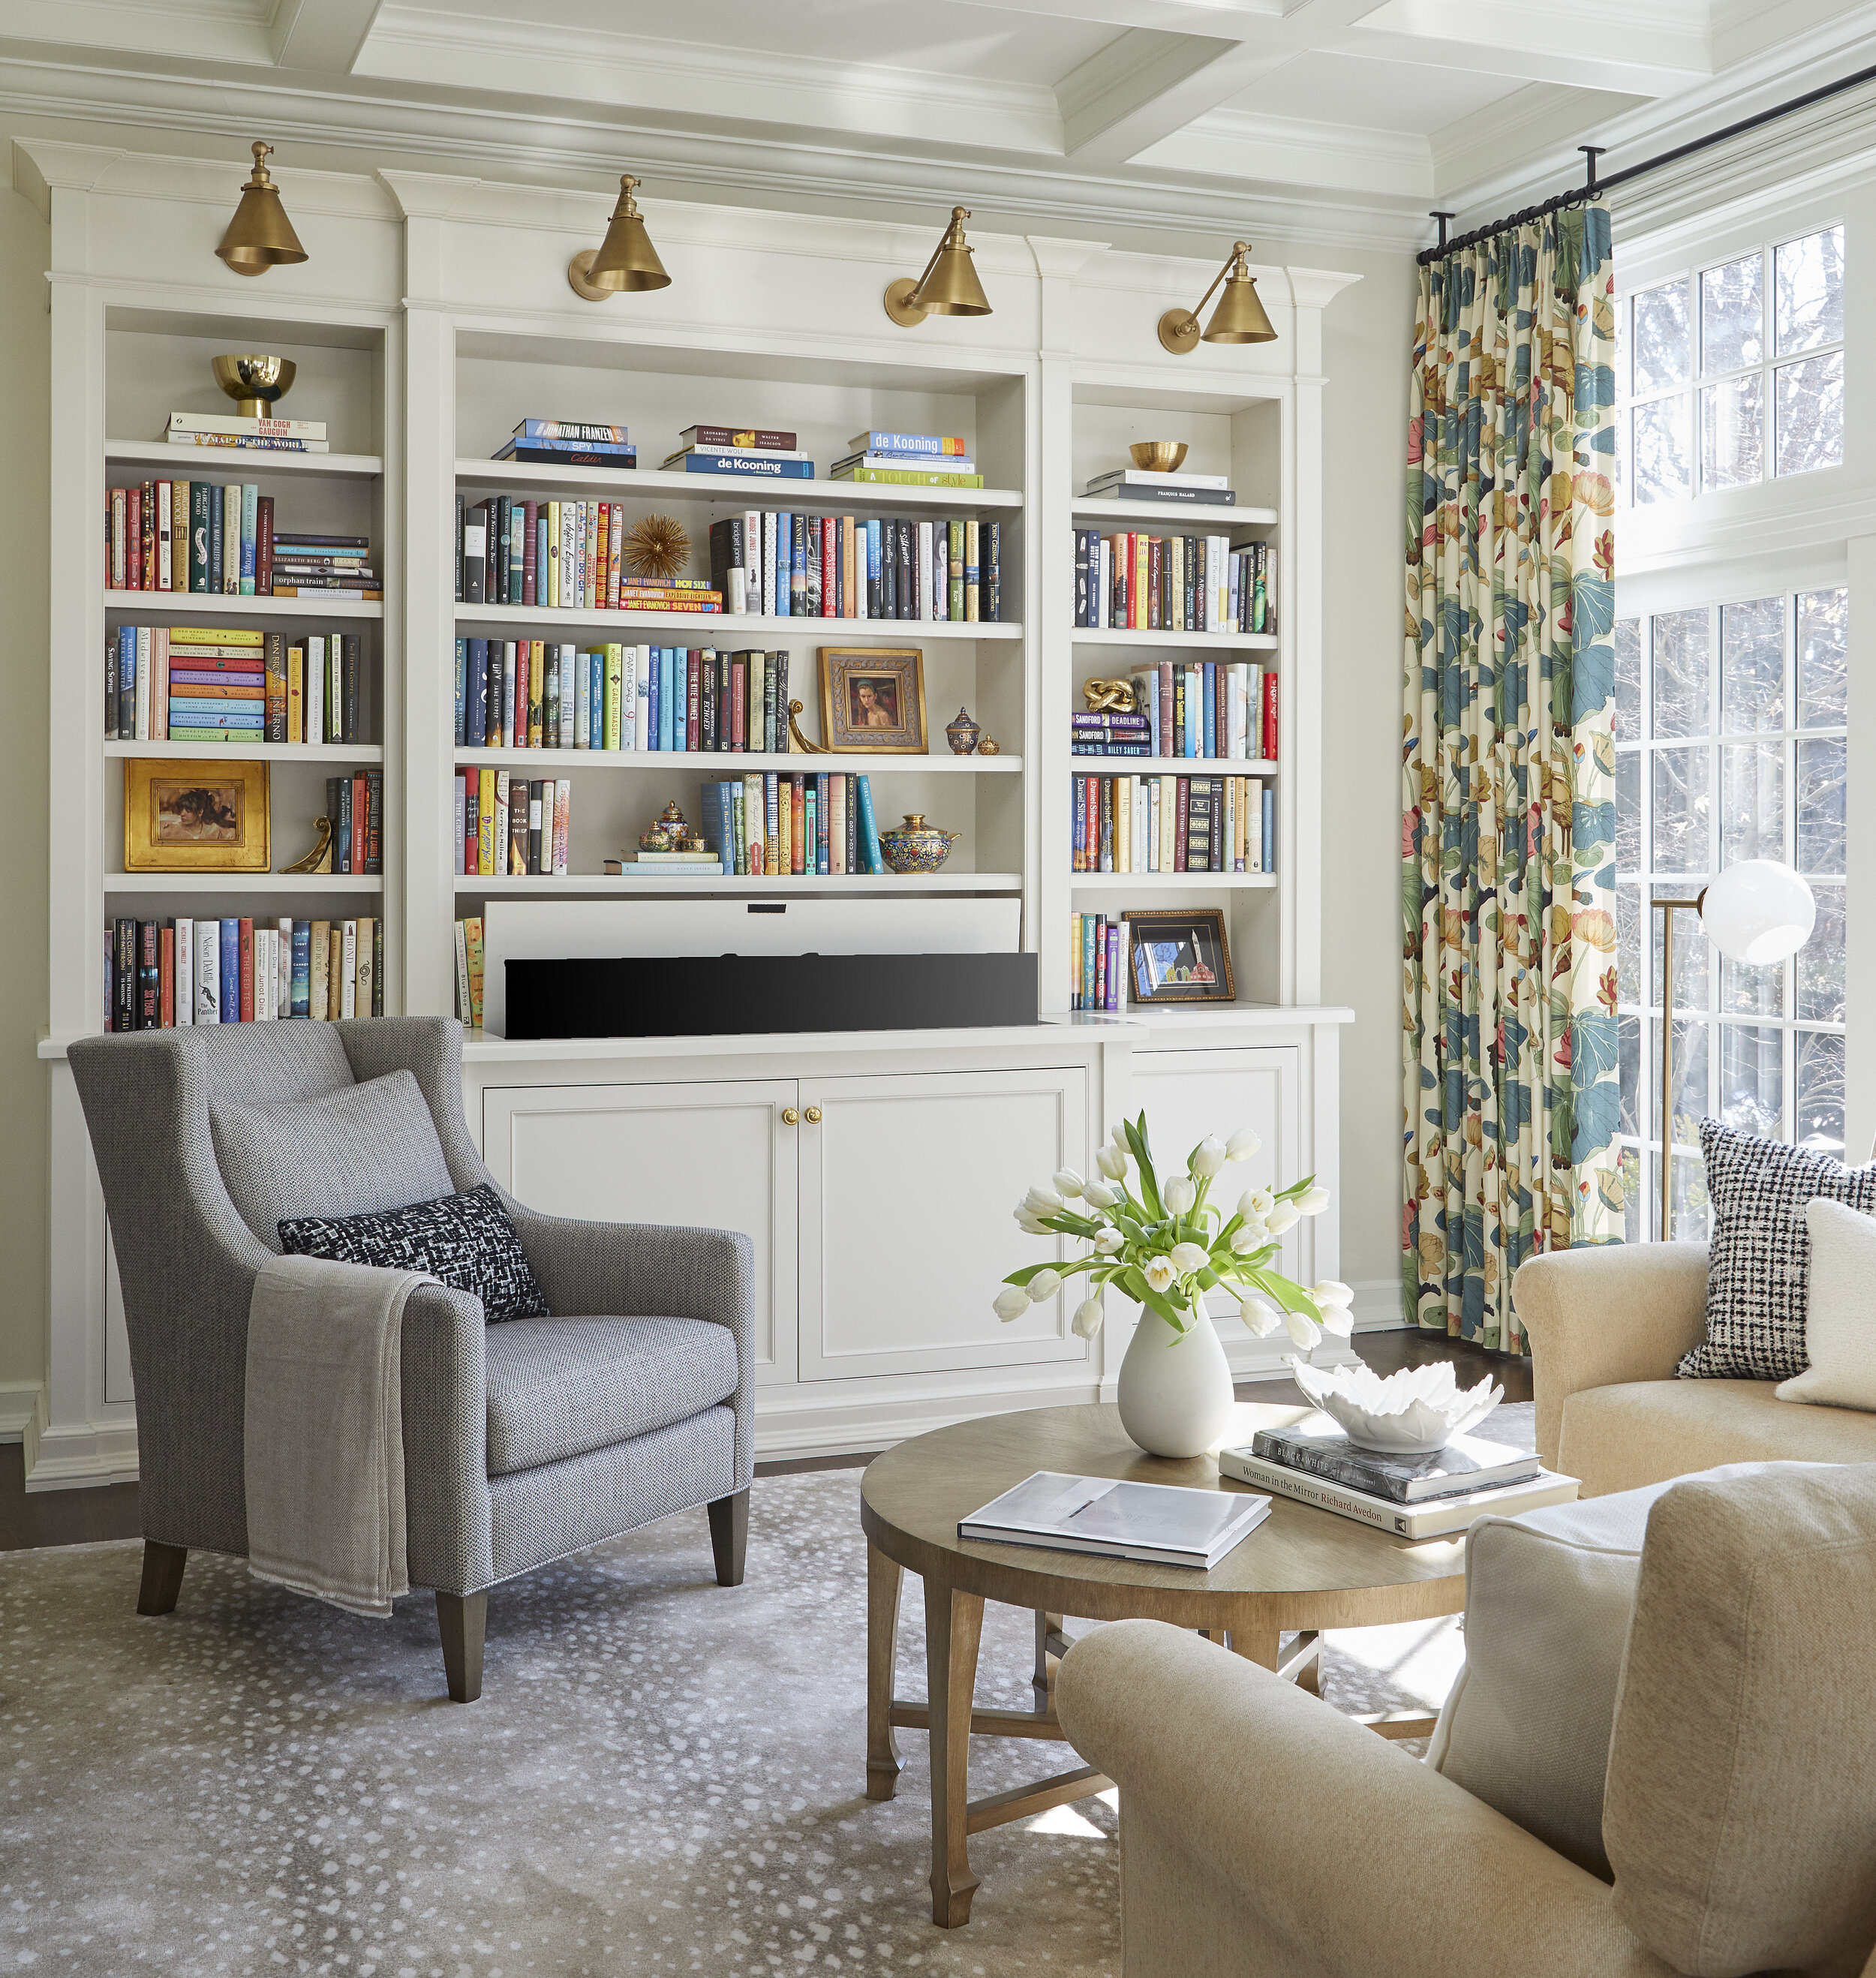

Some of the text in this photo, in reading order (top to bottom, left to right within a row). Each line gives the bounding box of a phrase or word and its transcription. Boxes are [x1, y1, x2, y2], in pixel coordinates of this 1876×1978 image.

[258, 419, 271, 427] VAN
[259, 427, 287, 436] GAUGUIN
[543, 423, 580, 438] JONATHAN
[582, 425, 615, 441] FRANZEN
[249, 438, 270, 447] THE
[273, 440, 308, 448] WORLD
[572, 442, 592, 451] SPY
[876, 434, 938, 453] de Kooning
[571, 454, 602, 463] Calder
[718, 458, 781, 473] de Kooning
[870, 473, 876, 481] A
[878, 471, 926, 485] TOUCH
[942, 473, 966, 487] style
[599, 513, 608, 528] JANET
[597, 529, 608, 557] EVANOVICH
[795, 516, 804, 571] FANNIE FLAGG
[562, 523, 574, 588] Jeffrey Eugenides
[609, 510, 622, 603] JANET EVANOVICH HIGH FIVE
[732, 548, 741, 566] jones
[597, 562, 606, 576] FOUR
[279, 576, 323, 585] orphan train
[627, 577, 706, 589] JANET EVANOVICH HOT SIX
[597, 584, 606, 600] SCORE
[639, 590, 664, 598] EVANOVICH
[627, 600, 714, 612] JANET EVANOVICH SEVEN UP
[140, 631, 149, 680] Midwives
[272, 657, 280, 688] BROWN
[562, 702, 573, 723] FALL
[690, 698, 698, 720] RUNNER
[269, 697, 283, 740] INFERNO
[1112, 717, 1140, 725] DEADLINE
[1108, 746, 1140, 755] RILEY SAGER
[767, 774, 778, 862] JONATHAN KELLERMAN KILLER
[867, 805, 875, 839] TRANSLATION
[1105, 805, 1113, 823] Silva
[144, 926, 155, 966] HARLAN COBEN
[203, 936, 212, 957] Nelson
[203, 960, 212, 984] DeMille
[144, 990, 155, 1015] SIX YEARS
[1277, 1447, 1300, 1462] BLACK
[1305, 1456, 1329, 1471] WHITE
[1356, 1474, 1375, 1487] between)
[1243, 1466, 1382, 1523] Woman in the Mirror Richard Avedon
